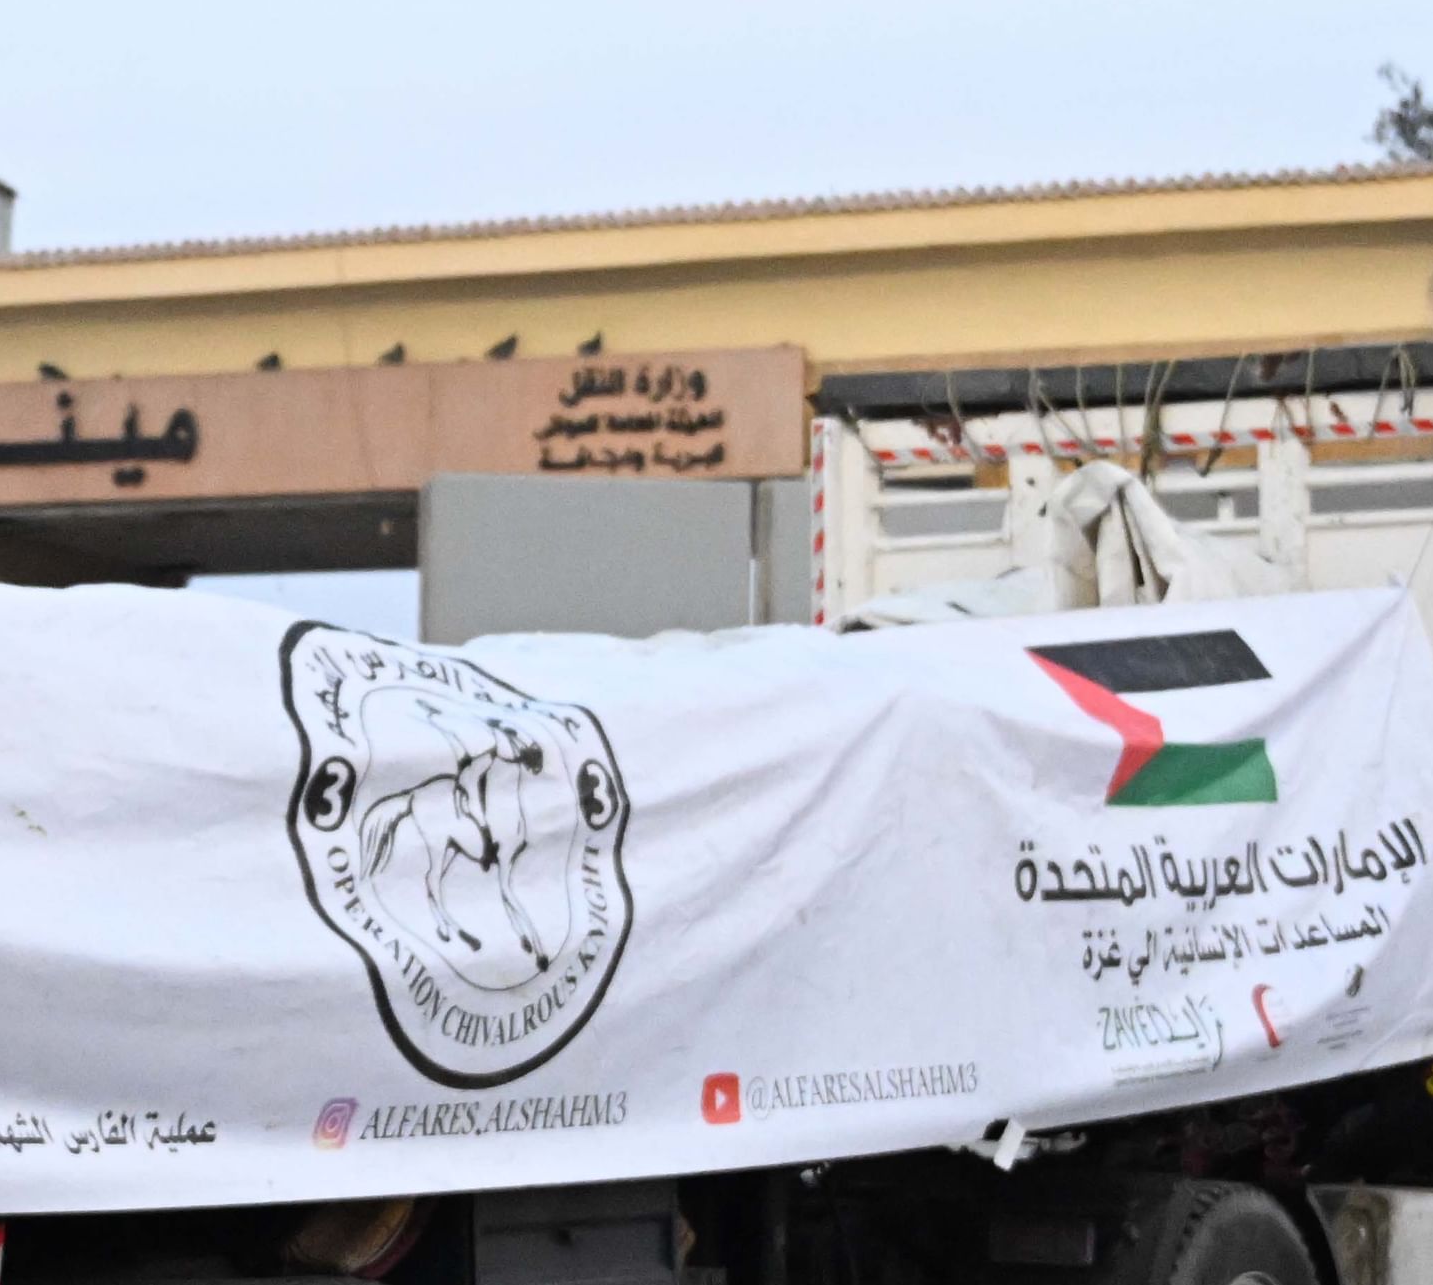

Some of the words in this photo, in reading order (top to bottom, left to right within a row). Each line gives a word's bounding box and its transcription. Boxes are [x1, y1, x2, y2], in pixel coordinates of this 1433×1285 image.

[315, 759, 350, 829] 3
[585, 761, 612, 829] 3
[1014, 838, 1158, 907] المتحدة
[1154, 834, 1269, 913] العربية
[1268, 818, 1427, 896] الإمارات
[327, 845, 446, 1020] OPERATION
[441, 965, 577, 1047] CHIVALROUS
[578, 836, 610, 973] KNIGHT
[1081, 929, 1122, 982] غزة
[1255, 903, 1391, 957] المساعدات
[360, 1091, 628, 1141] ALFARES.ALSHAHM3
[746, 1062, 979, 1120] @ALFARESALSHAHM3
[64, 1110, 136, 1155] الفارس
[144, 1110, 217, 1154] عملية
